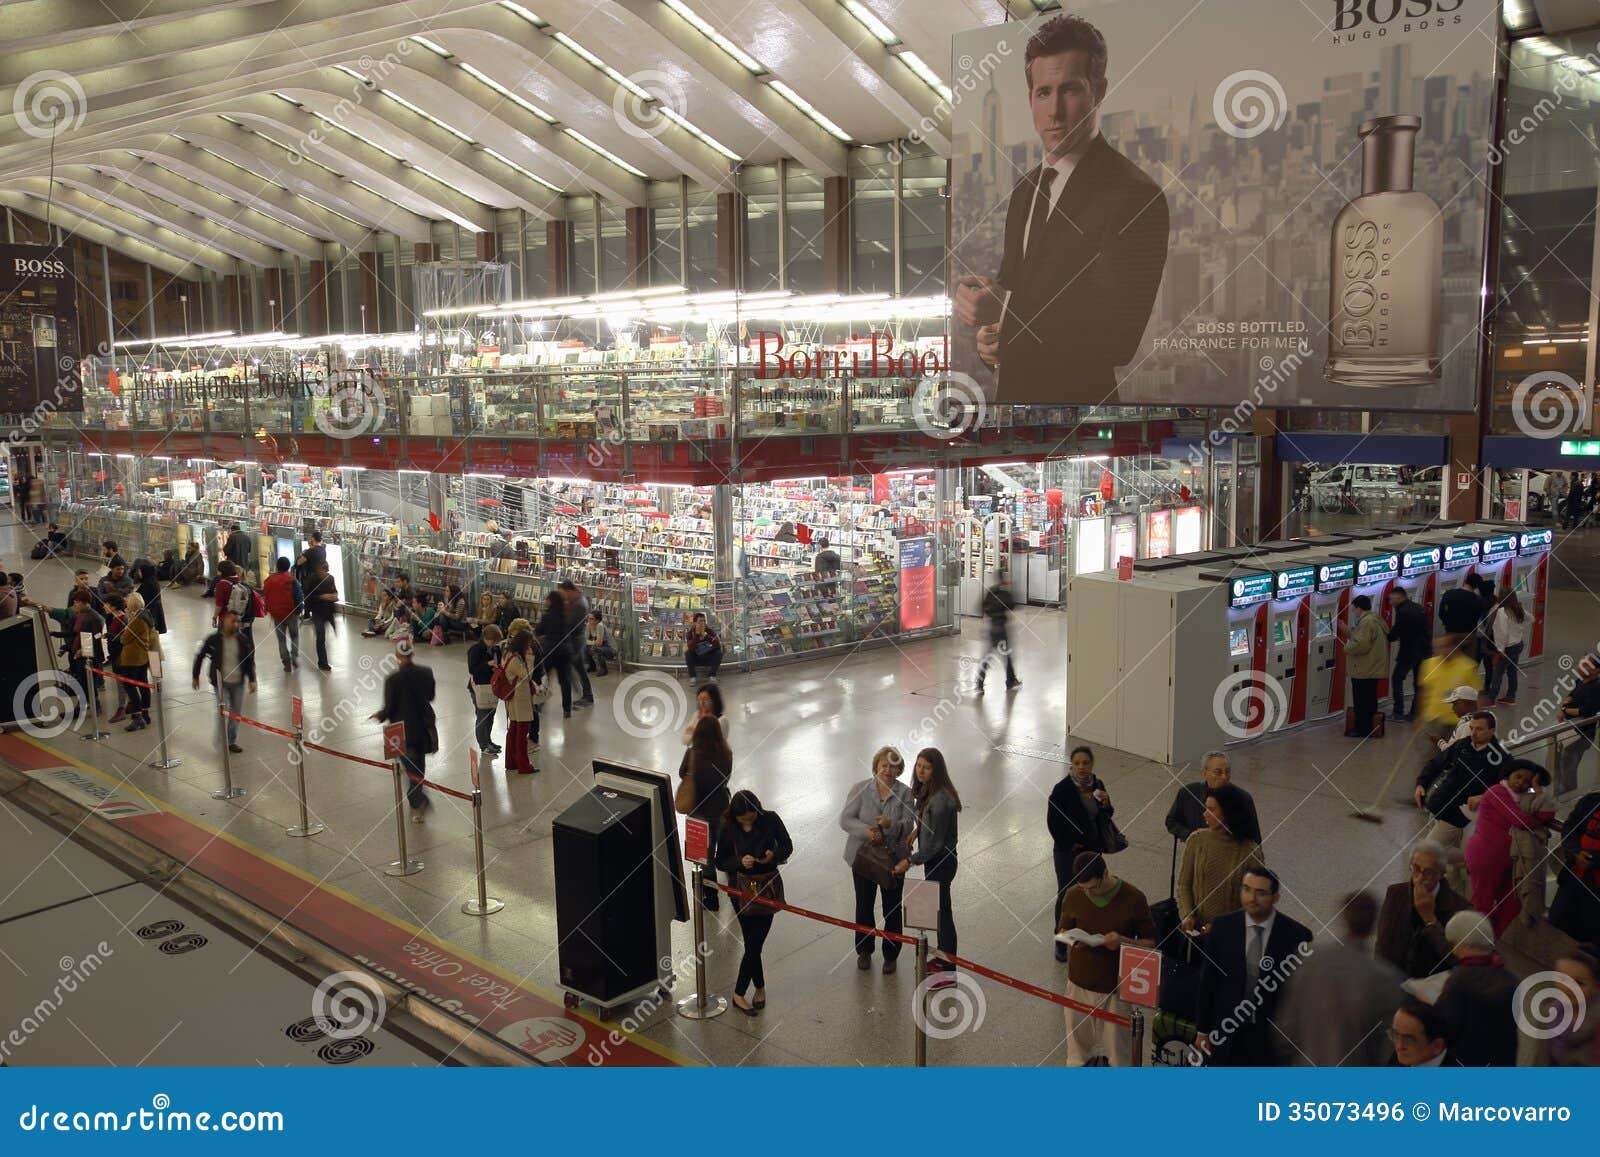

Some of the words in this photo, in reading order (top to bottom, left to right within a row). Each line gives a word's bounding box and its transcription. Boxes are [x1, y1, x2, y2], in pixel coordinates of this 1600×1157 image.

[1333, 28, 1386, 44] HUGO
[1403, 15, 1461, 32] BOSS
[1380, 223, 1391, 277] BOSS
[14, 258, 65, 275] BOSS
[1343, 221, 1379, 349] BOSS
[1196, 322, 1235, 334] BOSS
[1240, 321, 1309, 333] BOTTLED.
[1379, 292, 1390, 346] HUGO
[1153, 338, 1236, 350] FRAGRANCE
[1241, 337, 1270, 349] FOR
[1275, 337, 1309, 350] MEN
[403, 943, 464, 977] Office
[460, 973, 521, 1010] Ticket
[1129, 967, 1150, 995] 5
